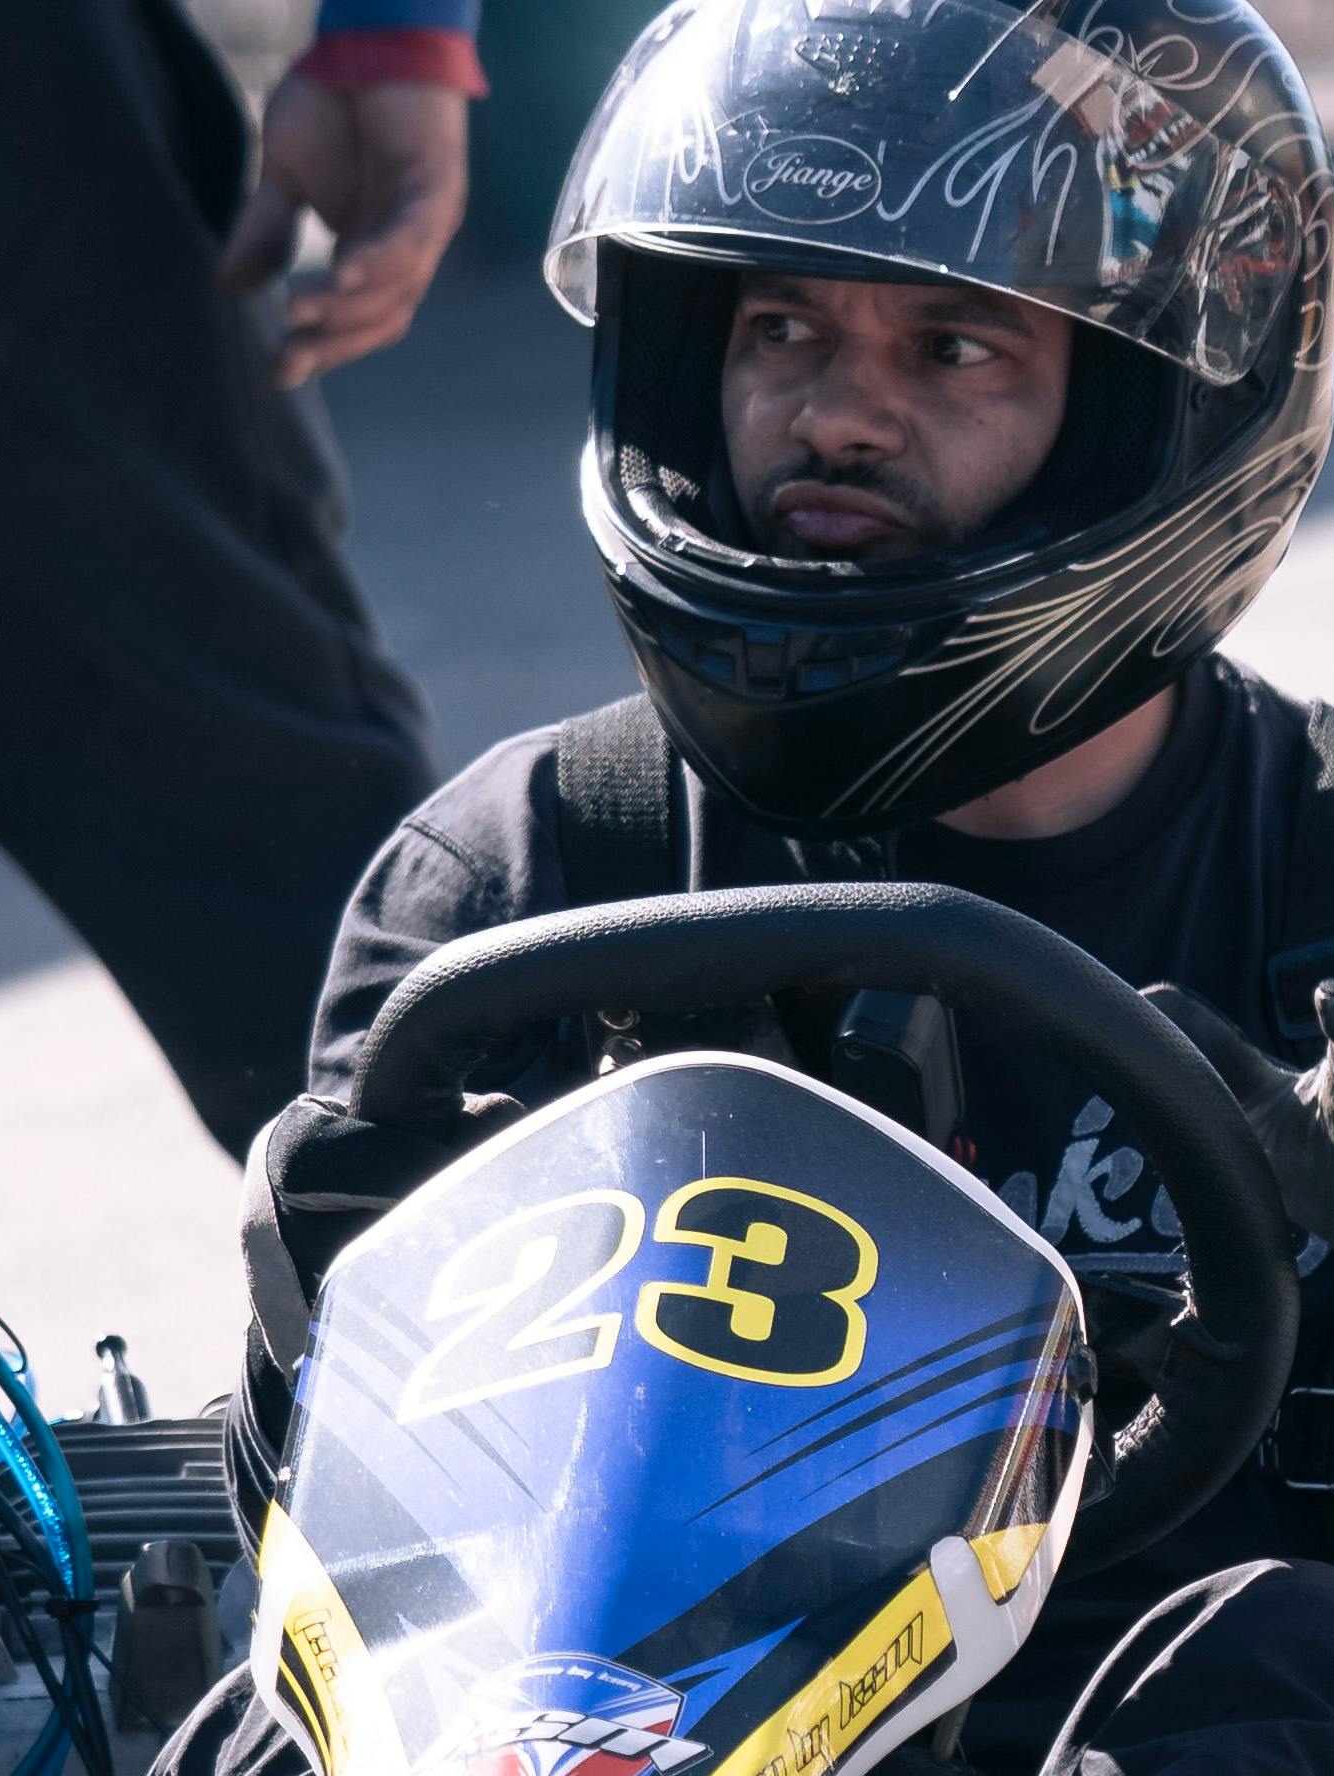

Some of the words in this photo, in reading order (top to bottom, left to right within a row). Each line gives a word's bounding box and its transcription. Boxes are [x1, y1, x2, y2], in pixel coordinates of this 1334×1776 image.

[751, 151, 876, 199] Jiange
[398, 1176, 879, 1424] 23
[839, 1610, 924, 1732] ksm
